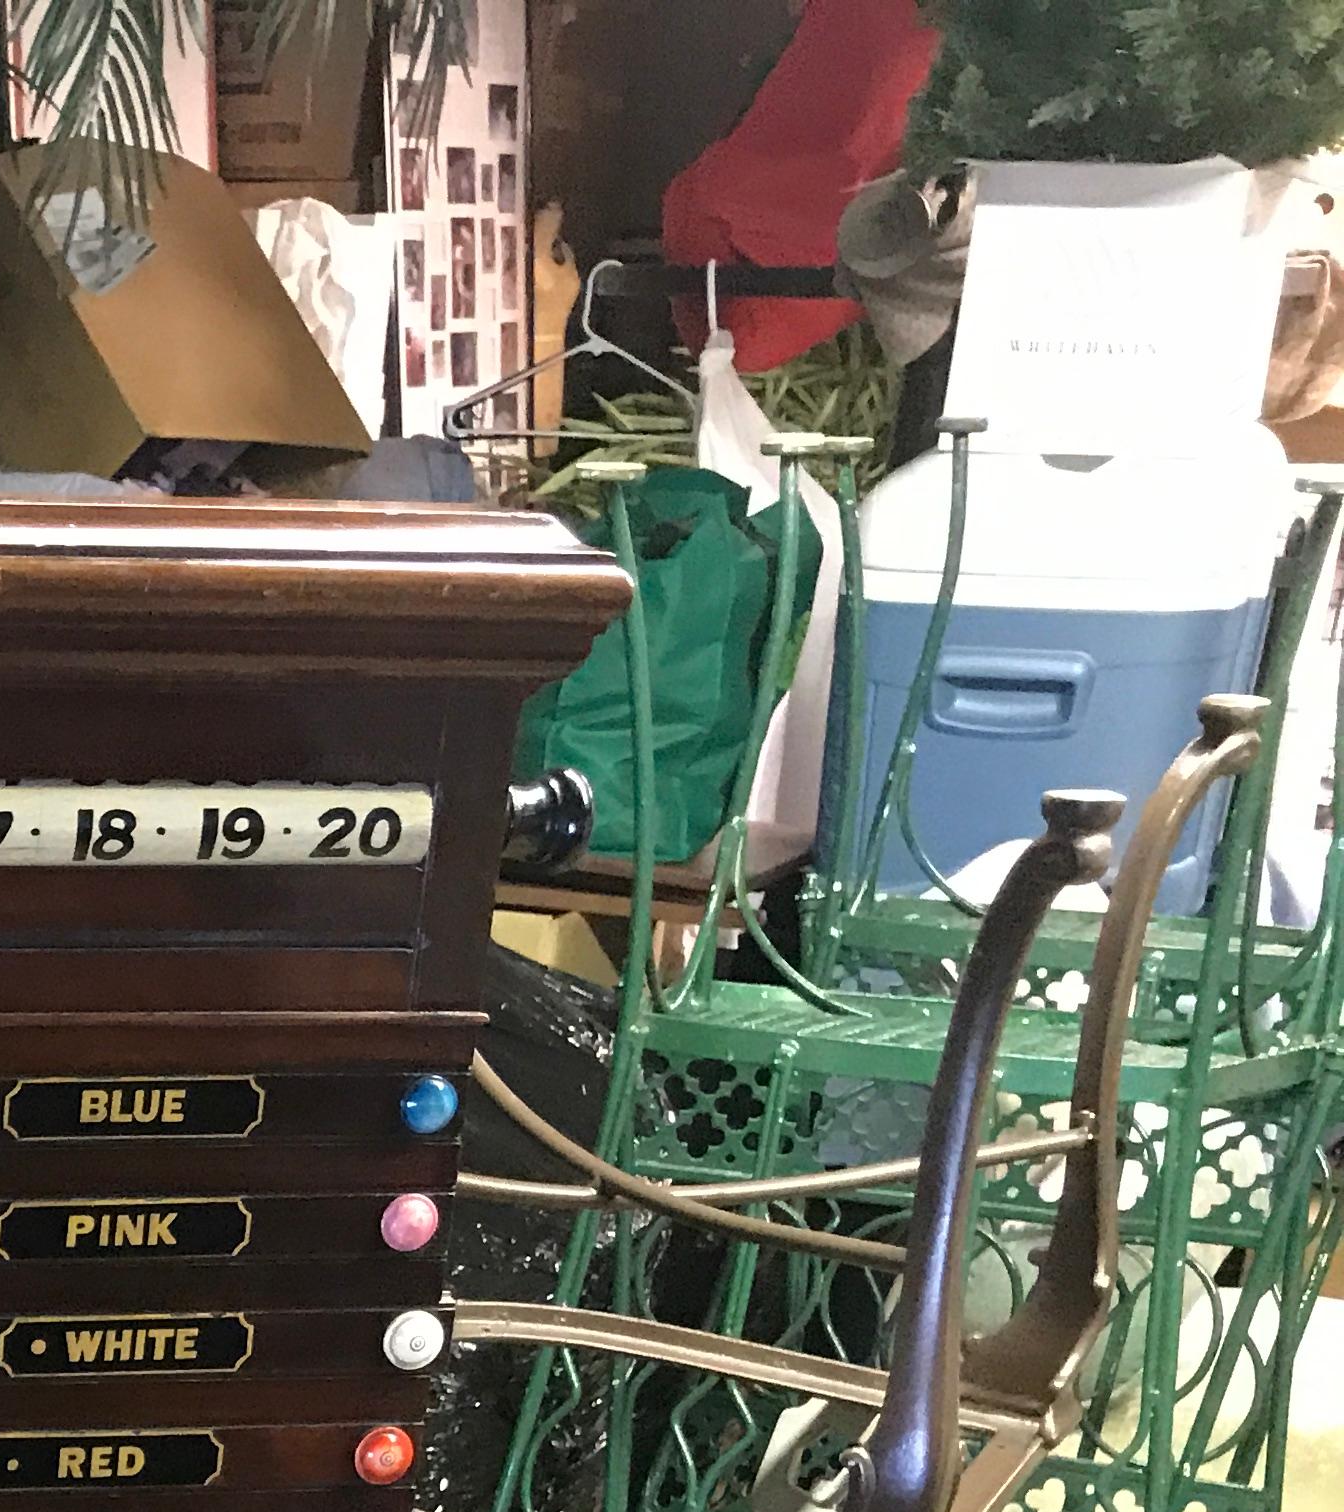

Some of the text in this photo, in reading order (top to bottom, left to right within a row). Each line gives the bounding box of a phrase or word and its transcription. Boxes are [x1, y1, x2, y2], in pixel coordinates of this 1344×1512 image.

[73, 809, 137, 862] 18
[197, 807, 264, 860] 19
[310, 806, 402, 859] 20
[80, 1089, 186, 1123] BLUE
[66, 1212, 178, 1247] PINK
[66, 1327, 199, 1362] WHITE
[57, 1446, 146, 1479] RED
